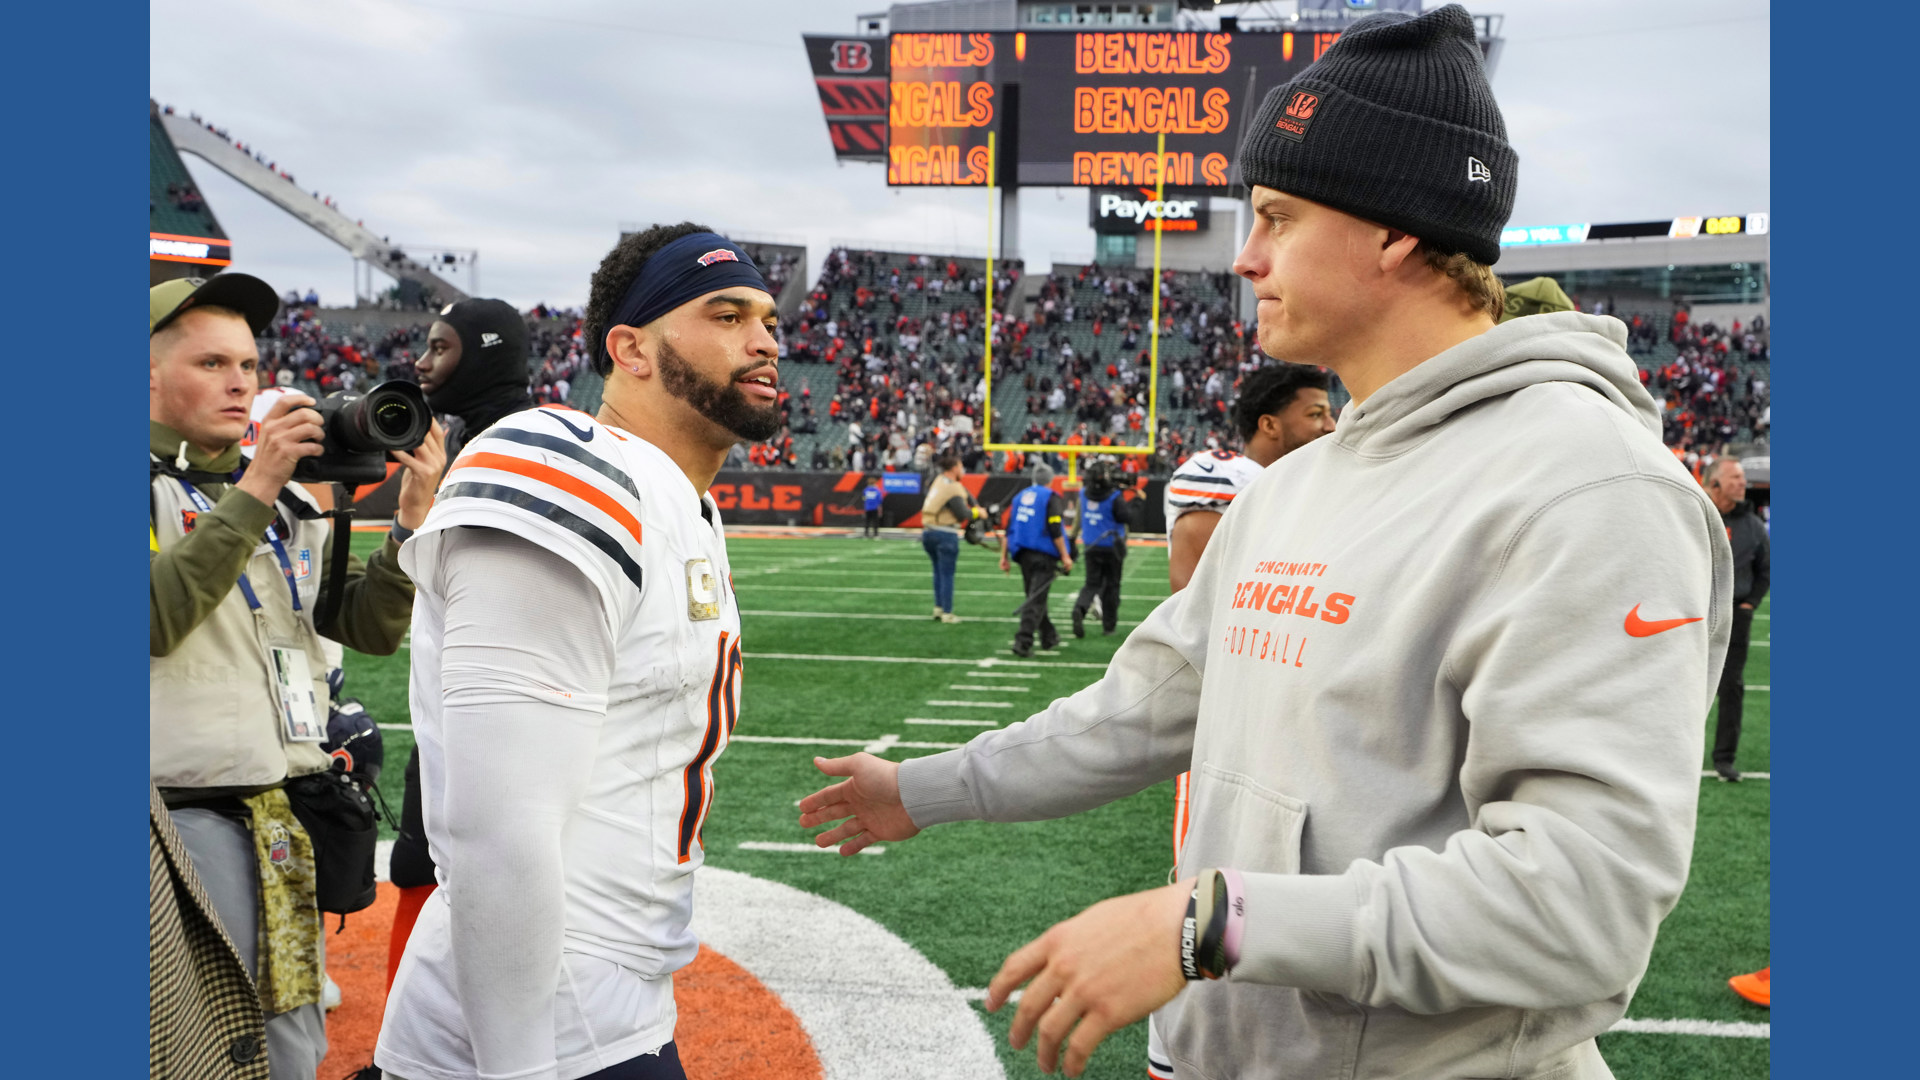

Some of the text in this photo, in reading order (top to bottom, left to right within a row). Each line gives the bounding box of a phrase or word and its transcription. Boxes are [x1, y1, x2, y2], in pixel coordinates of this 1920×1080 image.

[1076, 33, 1232, 74] BENGALS
[1074, 87, 1230, 134] BENGALS
[1276, 120, 1305, 135] BENGALS
[1100, 194, 1198, 224] Paycor
[690, 562, 718, 604] C
[1223, 626, 1307, 668] OOTBALL
